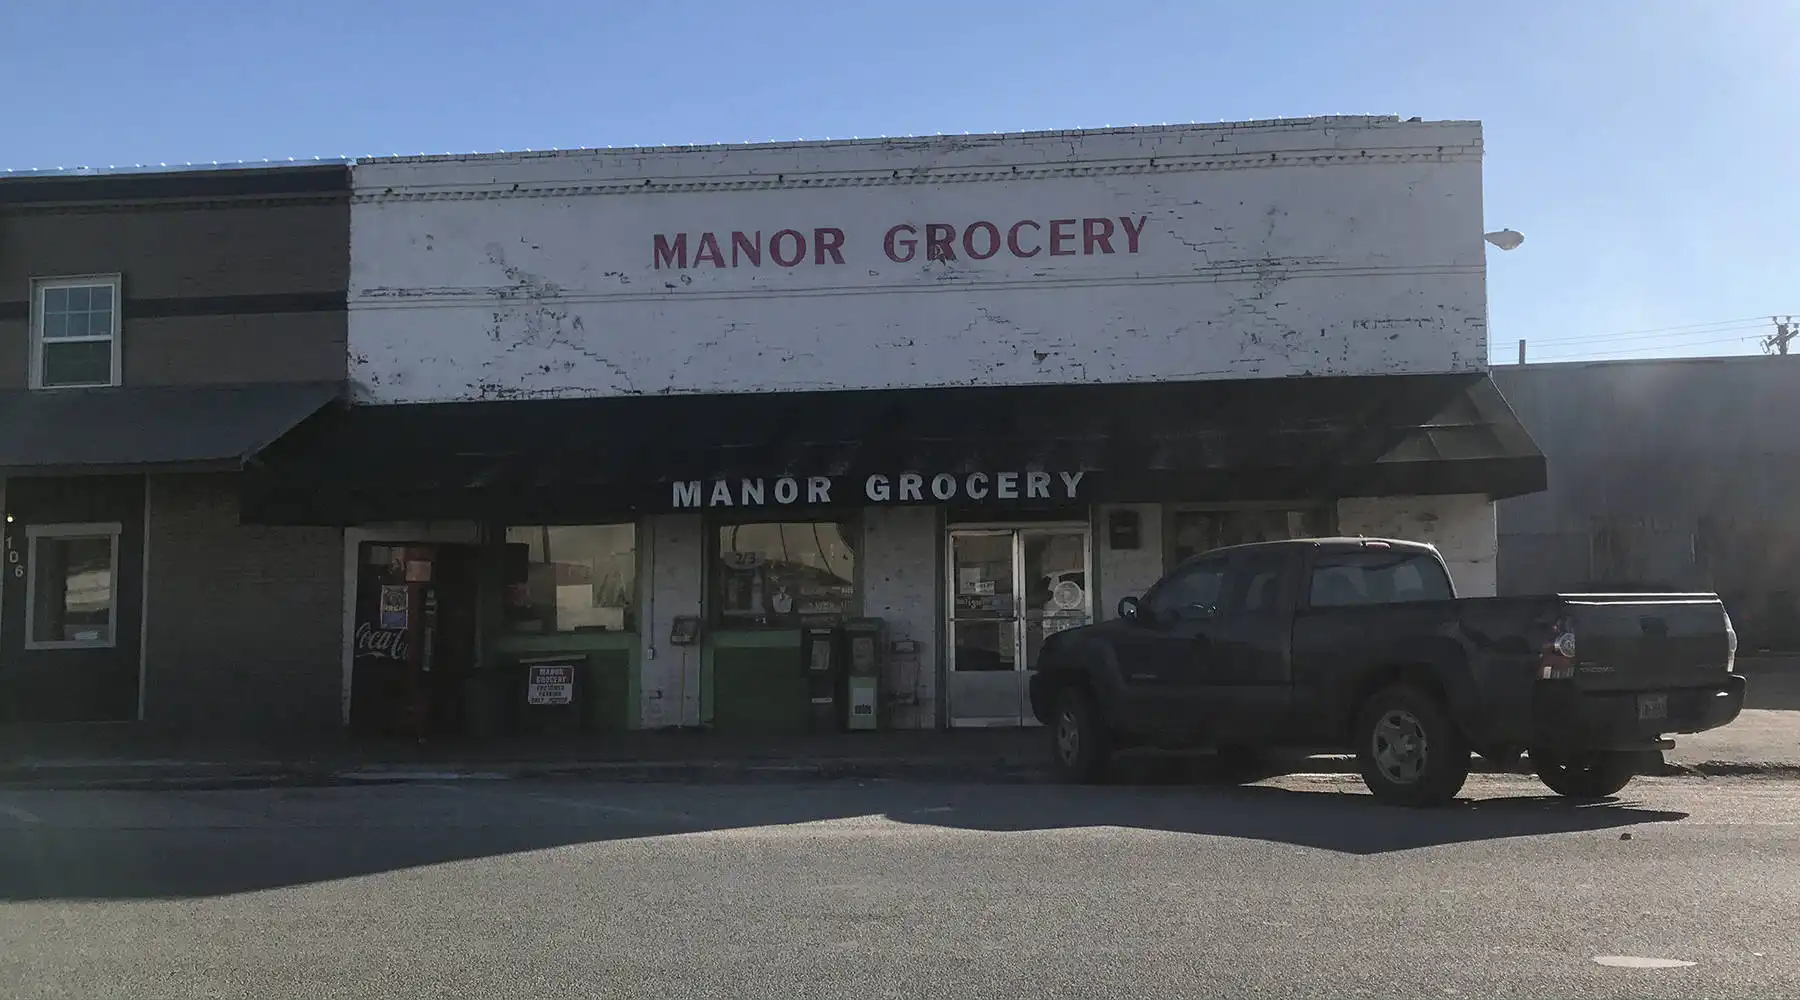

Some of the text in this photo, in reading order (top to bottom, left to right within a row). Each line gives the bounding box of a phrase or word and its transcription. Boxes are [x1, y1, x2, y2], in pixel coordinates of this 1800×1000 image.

[653, 215, 1147, 269] MANOR GROCERY
[672, 471, 1085, 508] MANOR GROCERY
